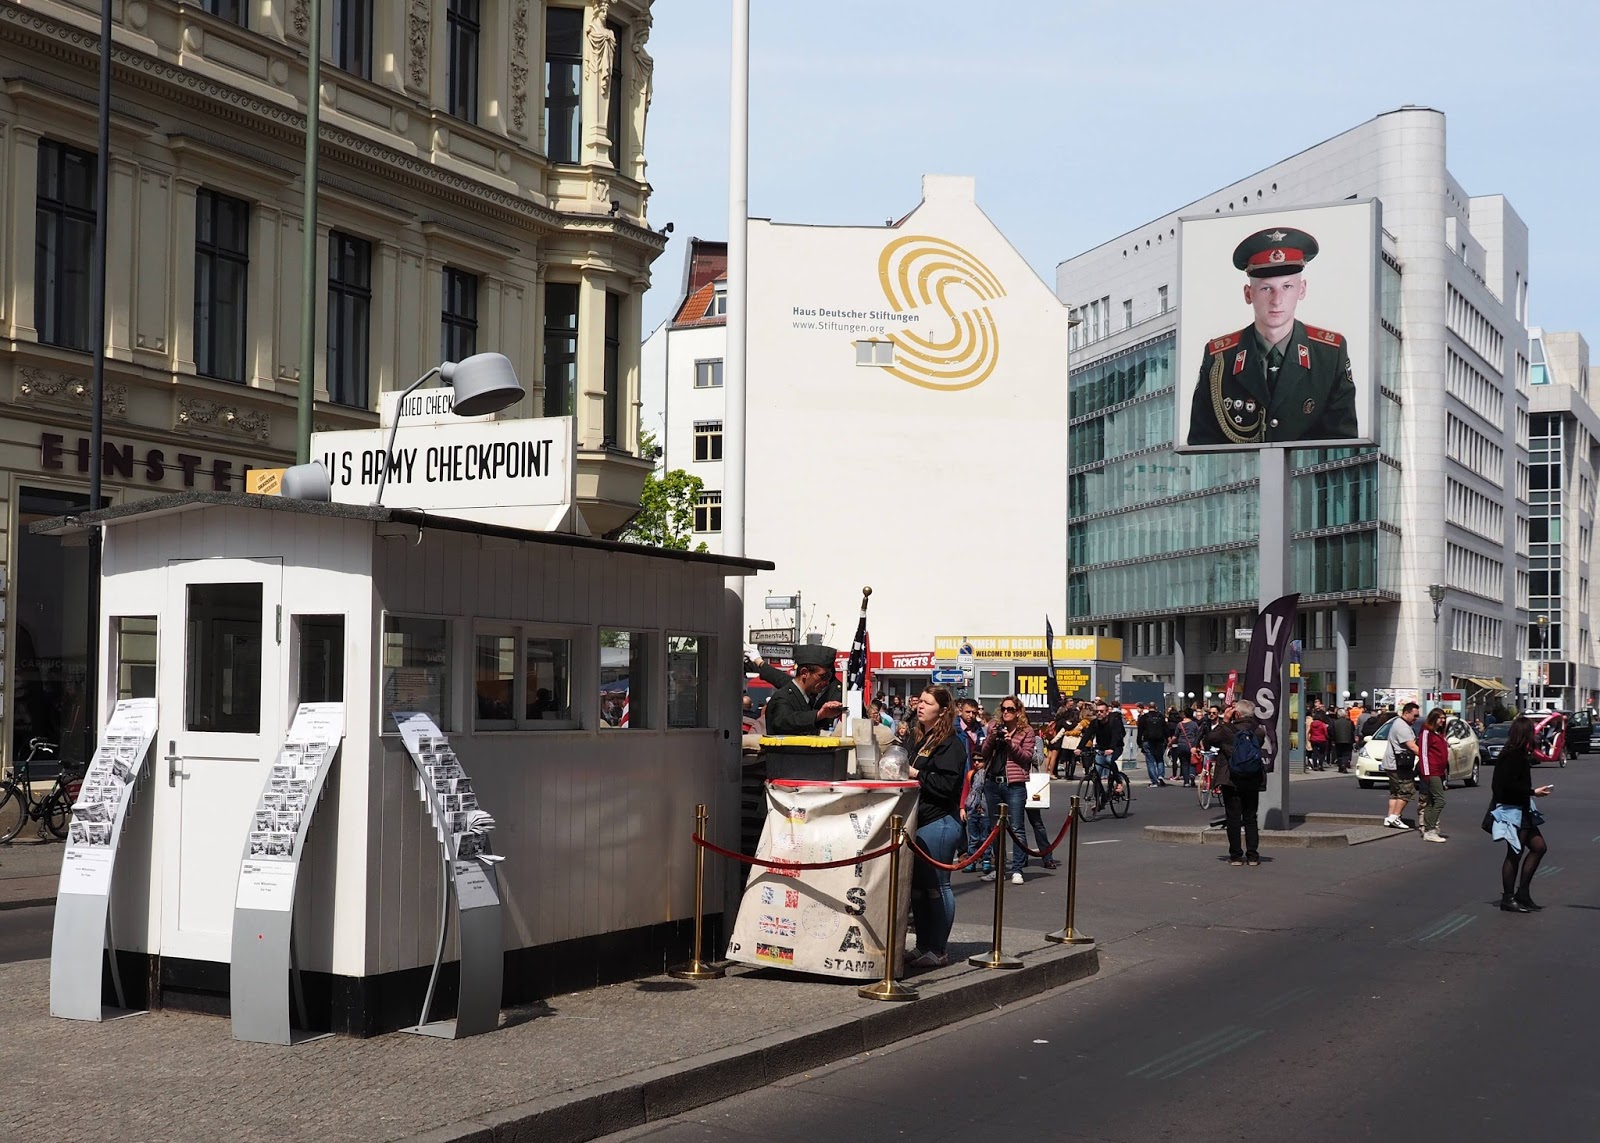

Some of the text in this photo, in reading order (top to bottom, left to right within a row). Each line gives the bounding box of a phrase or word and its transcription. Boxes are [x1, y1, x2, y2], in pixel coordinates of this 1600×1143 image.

[792, 306, 920, 323] Haus Deutscher Stiftungen
[792, 321, 885, 334] www.Stiftungen.org
[426, 394, 455, 415] CHECK
[361, 447, 418, 486] ARMY
[426, 439, 553, 483] CHECKPOINT
[1012, 638, 1043, 650] BERLIN
[976, 650, 1003, 658] WELCOME
[1004, 650, 1012, 658] TO
[1033, 650, 1049, 658] BERLI
[892, 656, 928, 668] TICKETS
[1017, 675, 1048, 694] THE
[1017, 693, 1050, 708] WALL
[823, 957, 875, 973] STAMP
